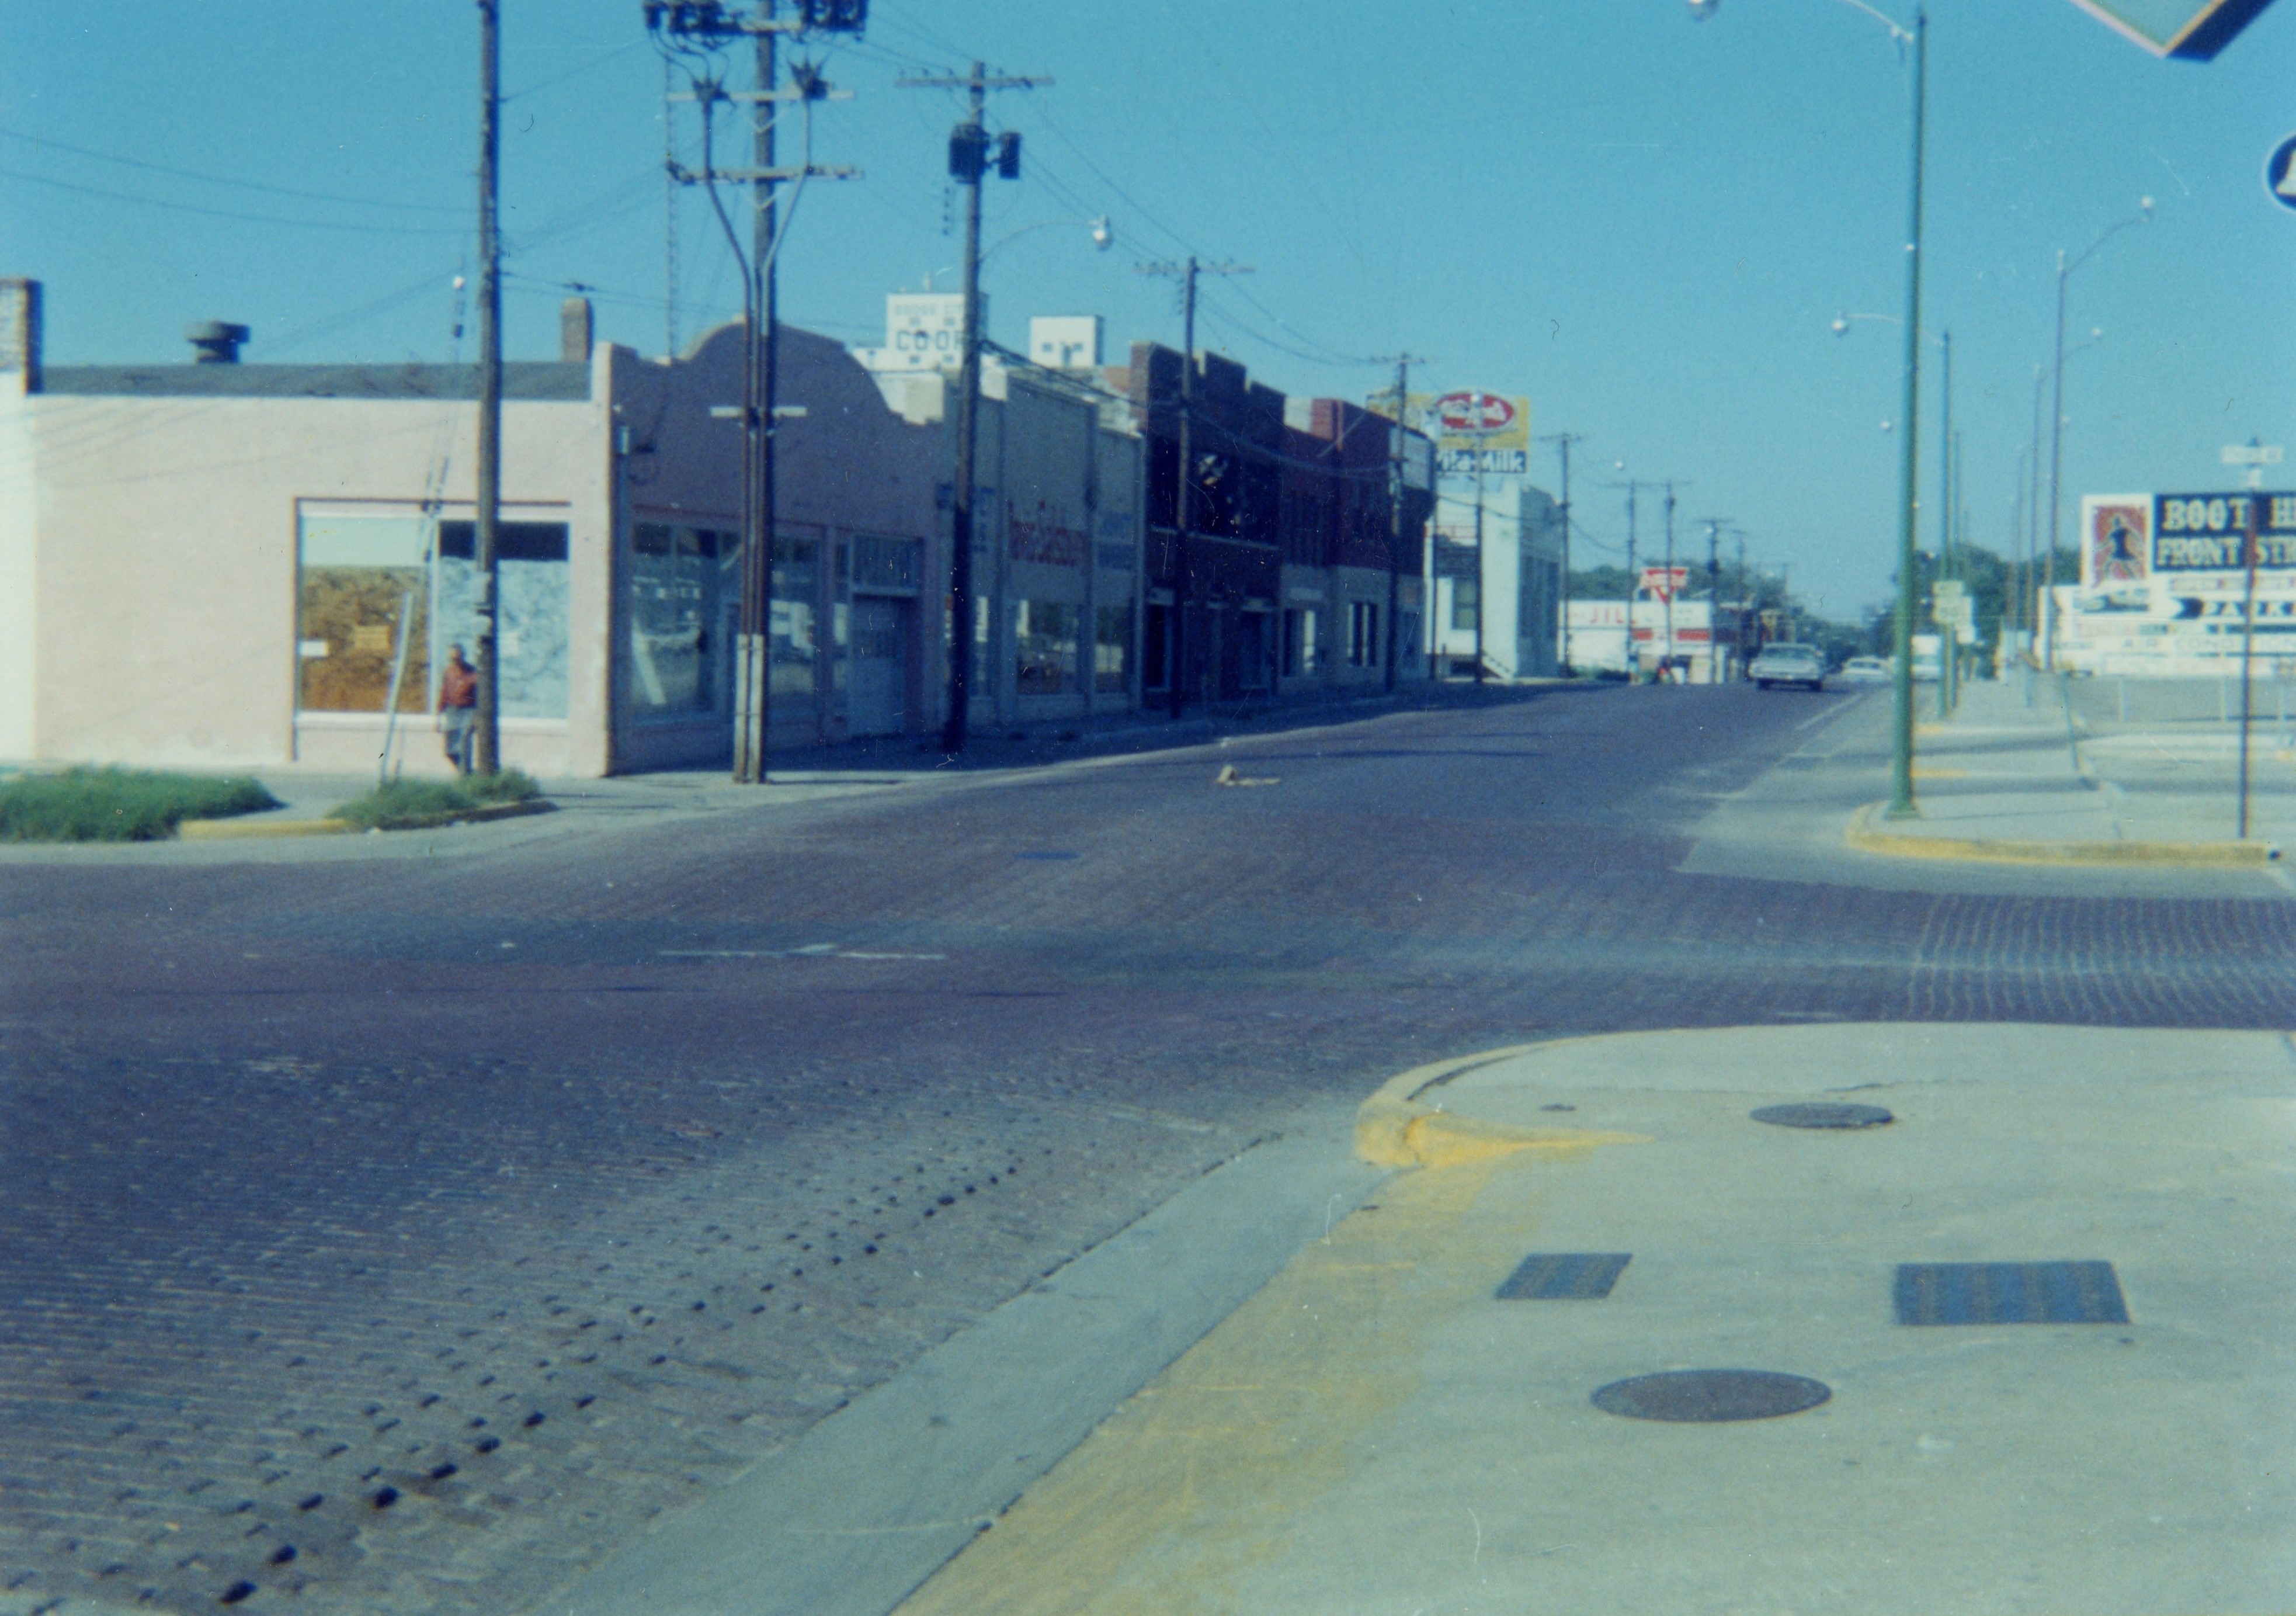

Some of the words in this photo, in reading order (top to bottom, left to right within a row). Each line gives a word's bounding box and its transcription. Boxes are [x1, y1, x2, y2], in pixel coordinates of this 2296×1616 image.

[2163, 498, 2251, 530] BOOT
[2157, 536, 2241, 566] FRONT
[1590, 606, 1637, 624] JIL
